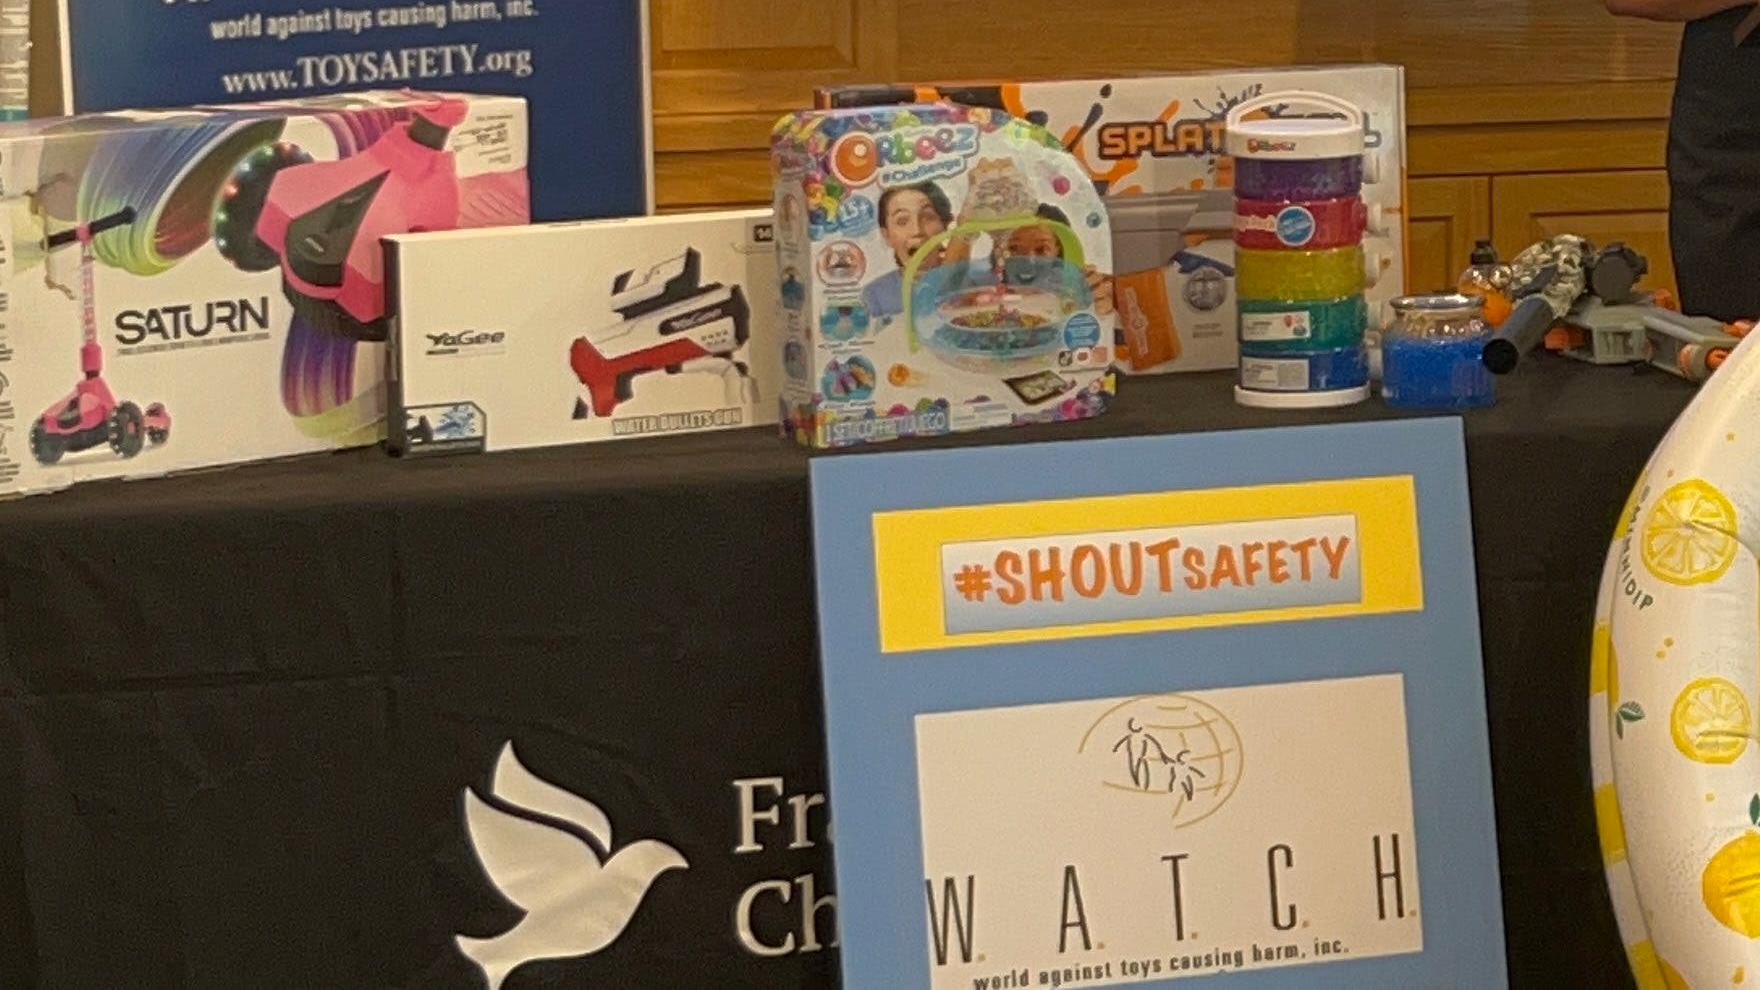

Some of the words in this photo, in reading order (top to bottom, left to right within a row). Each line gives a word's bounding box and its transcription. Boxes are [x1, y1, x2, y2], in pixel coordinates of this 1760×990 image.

[210, 14, 262, 40] world
[266, 9, 332, 40] against
[336, 7, 372, 34] toys
[378, 1, 446, 28] causing
[222, 42, 535, 94] www.TOYSAFETY.org
[1100, 119, 1228, 159] SPLAT
[115, 296, 270, 345] SATURN
[733, 776, 834, 854] Fr
[972, 968, 1030, 990] world
[1039, 962, 1113, 988] against
[1120, 955, 1162, 979] toys
[1169, 949, 1244, 973] causing
[1253, 942, 1306, 962] harm,
[1313, 936, 1350, 956] inc.
